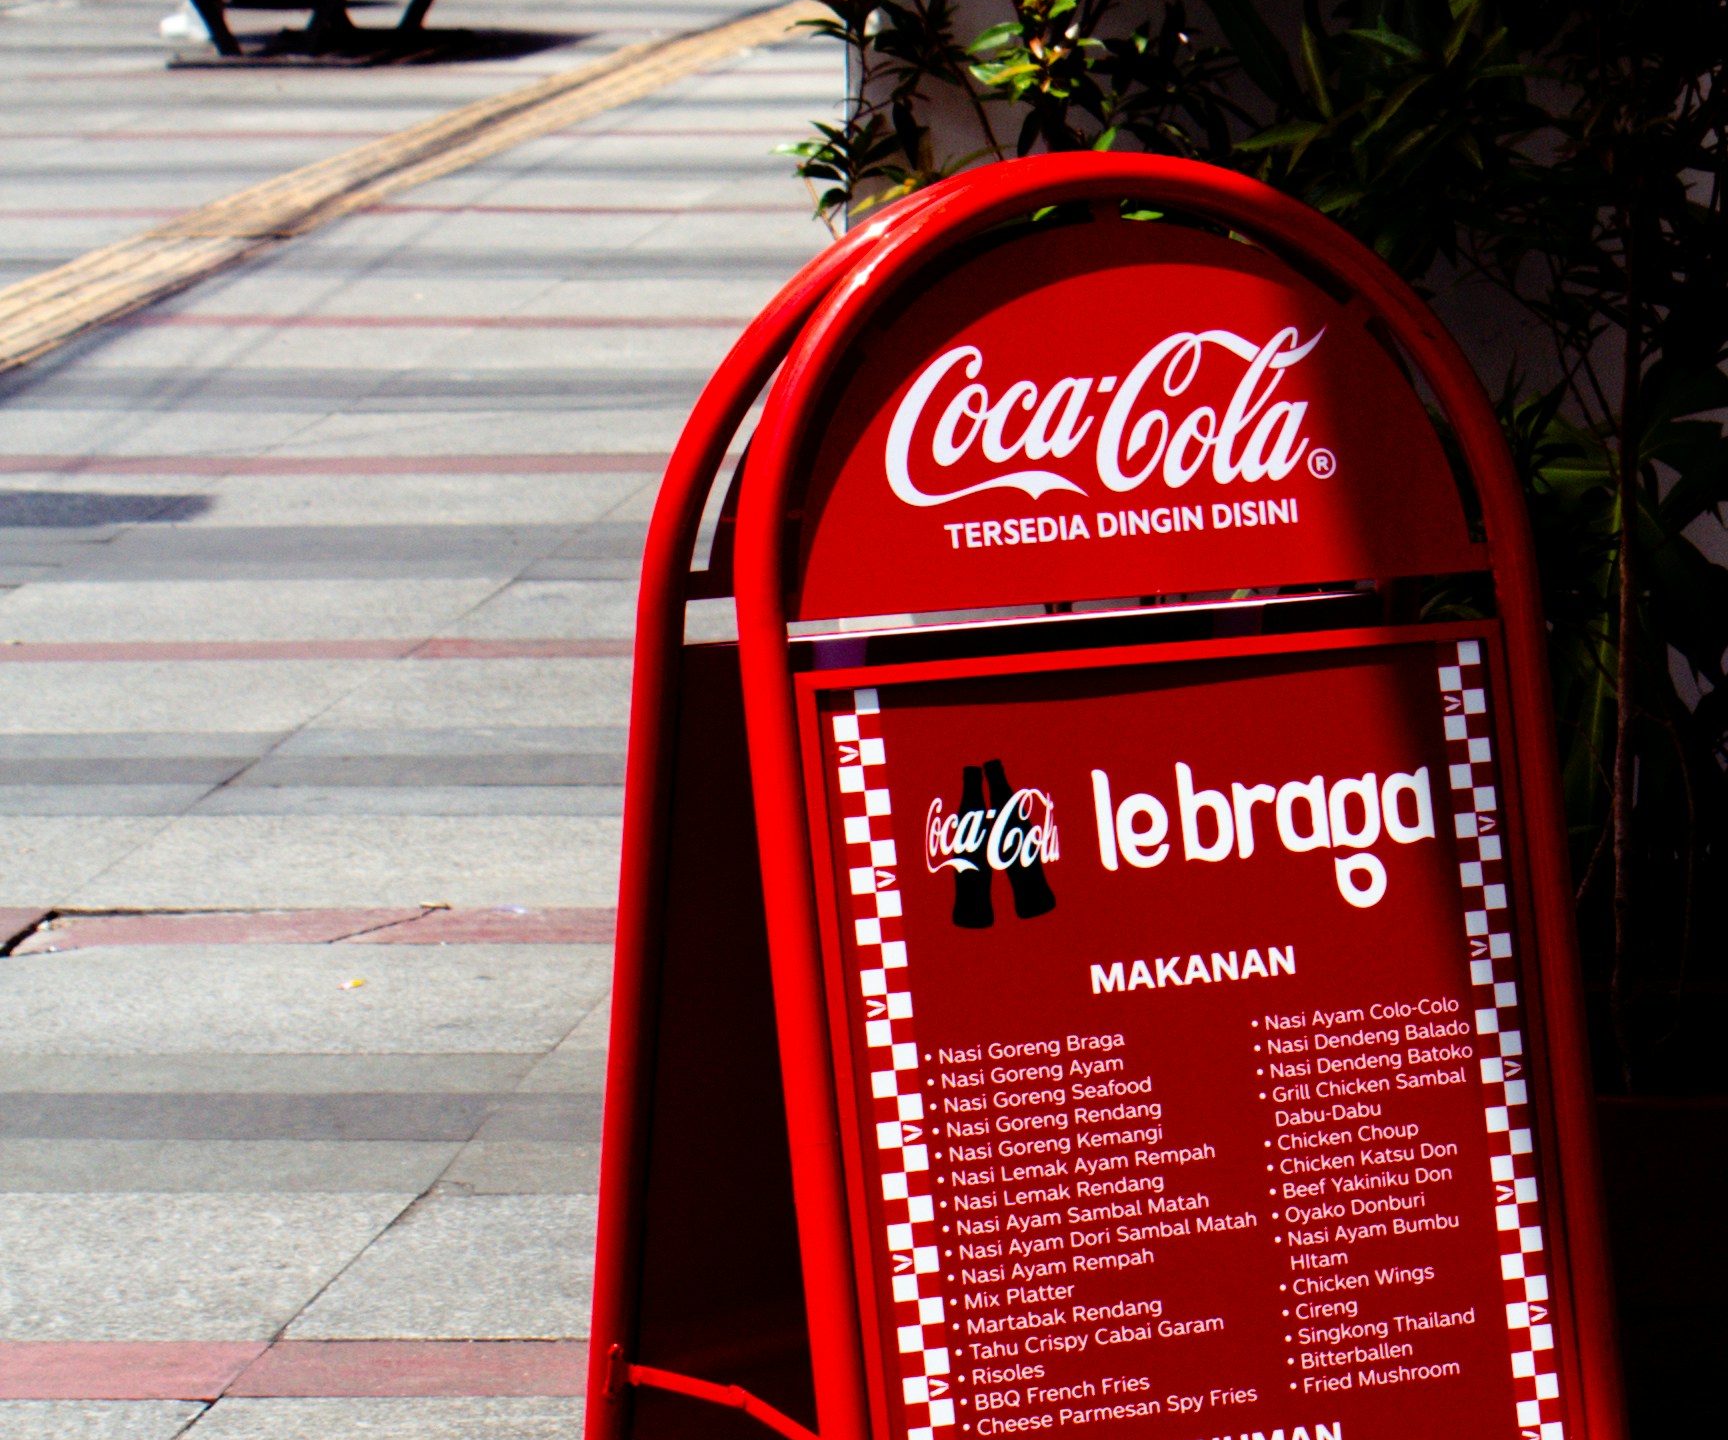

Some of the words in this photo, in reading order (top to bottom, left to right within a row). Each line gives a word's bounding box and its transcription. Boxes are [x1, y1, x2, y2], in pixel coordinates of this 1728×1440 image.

[944, 514, 1090, 549] TERSEDIA
[1096, 505, 1204, 538] DINGIN
[1211, 497, 1299, 530] DISINI
[1090, 945, 1297, 994] MAKANAN
[1265, 1011, 1306, 1030] Nasi
[1312, 1009, 1364, 1028] Ayam
[1370, 997, 1459, 1019] Colo-Colo
[939, 1045, 981, 1064] Nasi
[988, 1041, 1060, 1059] Goreng
[1067, 1034, 1125, 1051] Braga
[1268, 1035, 1308, 1054] Nasi
[1315, 1030, 1399, 1049] Dendeng
[1405, 1020, 1469, 1040] Balado
[941, 1069, 984, 1088] Nasi
[991, 1065, 1063, 1083] Goreng
[1070, 1059, 1123, 1078] Ayam
[1270, 1059, 1311, 1078] Nasi
[1317, 1053, 1402, 1073] Dendeng
[1408, 1044, 1473, 1064] Batoko
[944, 1093, 987, 1113] Nasi
[993, 1089, 1065, 1108] Goreng
[1072, 1076, 1151, 1100] Seafood
[1273, 1084, 1310, 1102] Grill
[1316, 1078, 1390, 1098] Chicken
[1396, 1067, 1466, 1089] Sambal
[947, 1118, 989, 1137] Nasi
[996, 1113, 1068, 1132] Goreng
[1074, 1104, 1161, 1124] Rendang
[1275, 1102, 1381, 1127] Dabu-Dabu
[949, 1142, 992, 1162] Nasi
[998, 1138, 1070, 1157] Goreng
[1077, 1124, 1162, 1148] Kemangi
[1278, 1131, 1352, 1150] Chicken
[1358, 1124, 1418, 1141] Choup
[952, 1167, 994, 1186] Nasi
[1001, 1159, 1068, 1181] Lemak
[1075, 1156, 1128, 1175] Ayam
[1135, 1143, 1215, 1166] Rempah
[1280, 1155, 1354, 1174] Chicken
[1361, 1149, 1414, 1165] Katsu
[1421, 1143, 1457, 1159] Don
[954, 1191, 997, 1211] Nasi
[1004, 1184, 1070, 1206] Lemak
[1077, 1177, 1164, 1197] Rendang
[1283, 1178, 1325, 1199] Beef
[1331, 1171, 1409, 1192] Yakiniku
[1415, 1168, 1452, 1183] Don
[957, 1216, 999, 1236] Nasi
[1006, 1213, 1061, 1232] Ayam
[1067, 1200, 1142, 1223] Sambal
[1148, 1193, 1209, 1214] Matah
[1285, 1203, 1345, 1225] Oyako
[1351, 1192, 1425, 1215] Donburi
[959, 1240, 1002, 1260] Nasi
[1009, 1237, 1064, 1257] Ayam
[1070, 1228, 1110, 1247] Dori
[1117, 1219, 1191, 1242] Sambal
[1196, 1212, 1257, 1232] Matah
[1288, 1227, 1328, 1246] Nasi
[1335, 1224, 1387, 1243] Ayam
[1393, 1214, 1459, 1234] Bumbu
[962, 1265, 1005, 1285] Nasi
[1012, 1261, 1066, 1281] Ayam
[1073, 1248, 1154, 1271] Rempah
[1293, 1275, 1369, 1295] Chicken
[1375, 1267, 1434, 1285] Wings
[965, 1293, 1000, 1310] Mix
[1007, 1285, 1074, 1304] Platter
[1296, 1301, 1358, 1320] Cireng
[967, 1309, 1066, 1335] Martabak
[1073, 1301, 1162, 1322] Rendang
[1298, 1322, 1388, 1344] Singkong
[1393, 1307, 1475, 1332] Thailand
[969, 1341, 1018, 1359] Tahu
[1025, 1335, 1088, 1353] Crispy
[1095, 1322, 1151, 1345] Cabai
[1158, 1318, 1224, 1337] Garam
[1301, 1343, 1413, 1369] Bitterballen
[972, 1364, 1045, 1385] Risoles
[1304, 1373, 1352, 1393] Fried
[1359, 1363, 1460, 1386] Mushroom
[975, 1390, 1020, 1411] BBQ
[1027, 1381, 1095, 1404] French
[1102, 1377, 1150, 1394] Fries
[977, 1415, 1053, 1435] Cheese
[1060, 1401, 1160, 1425] Parmesan
[1167, 1395, 1203, 1413] Spy
[1210, 1389, 1257, 1406] Fries
